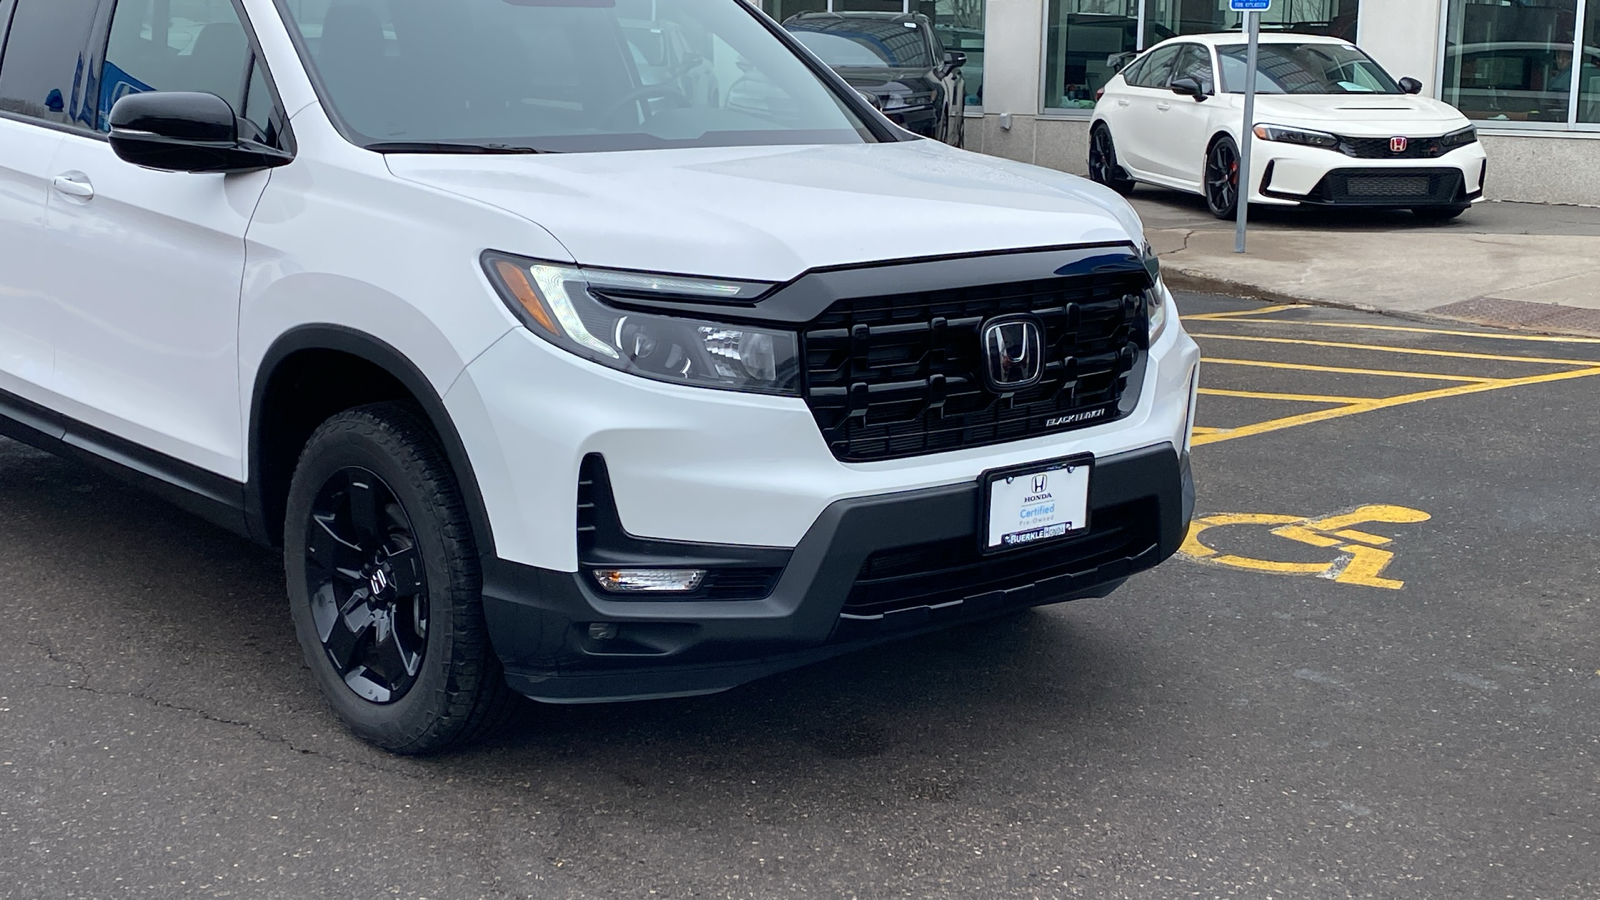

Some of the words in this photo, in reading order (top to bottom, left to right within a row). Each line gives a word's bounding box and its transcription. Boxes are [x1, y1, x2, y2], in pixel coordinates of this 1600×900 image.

[1024, 493, 1052, 503] HONDA
[1020, 503, 1055, 519] Certified
[1010, 530, 1044, 544] BUERKLE
